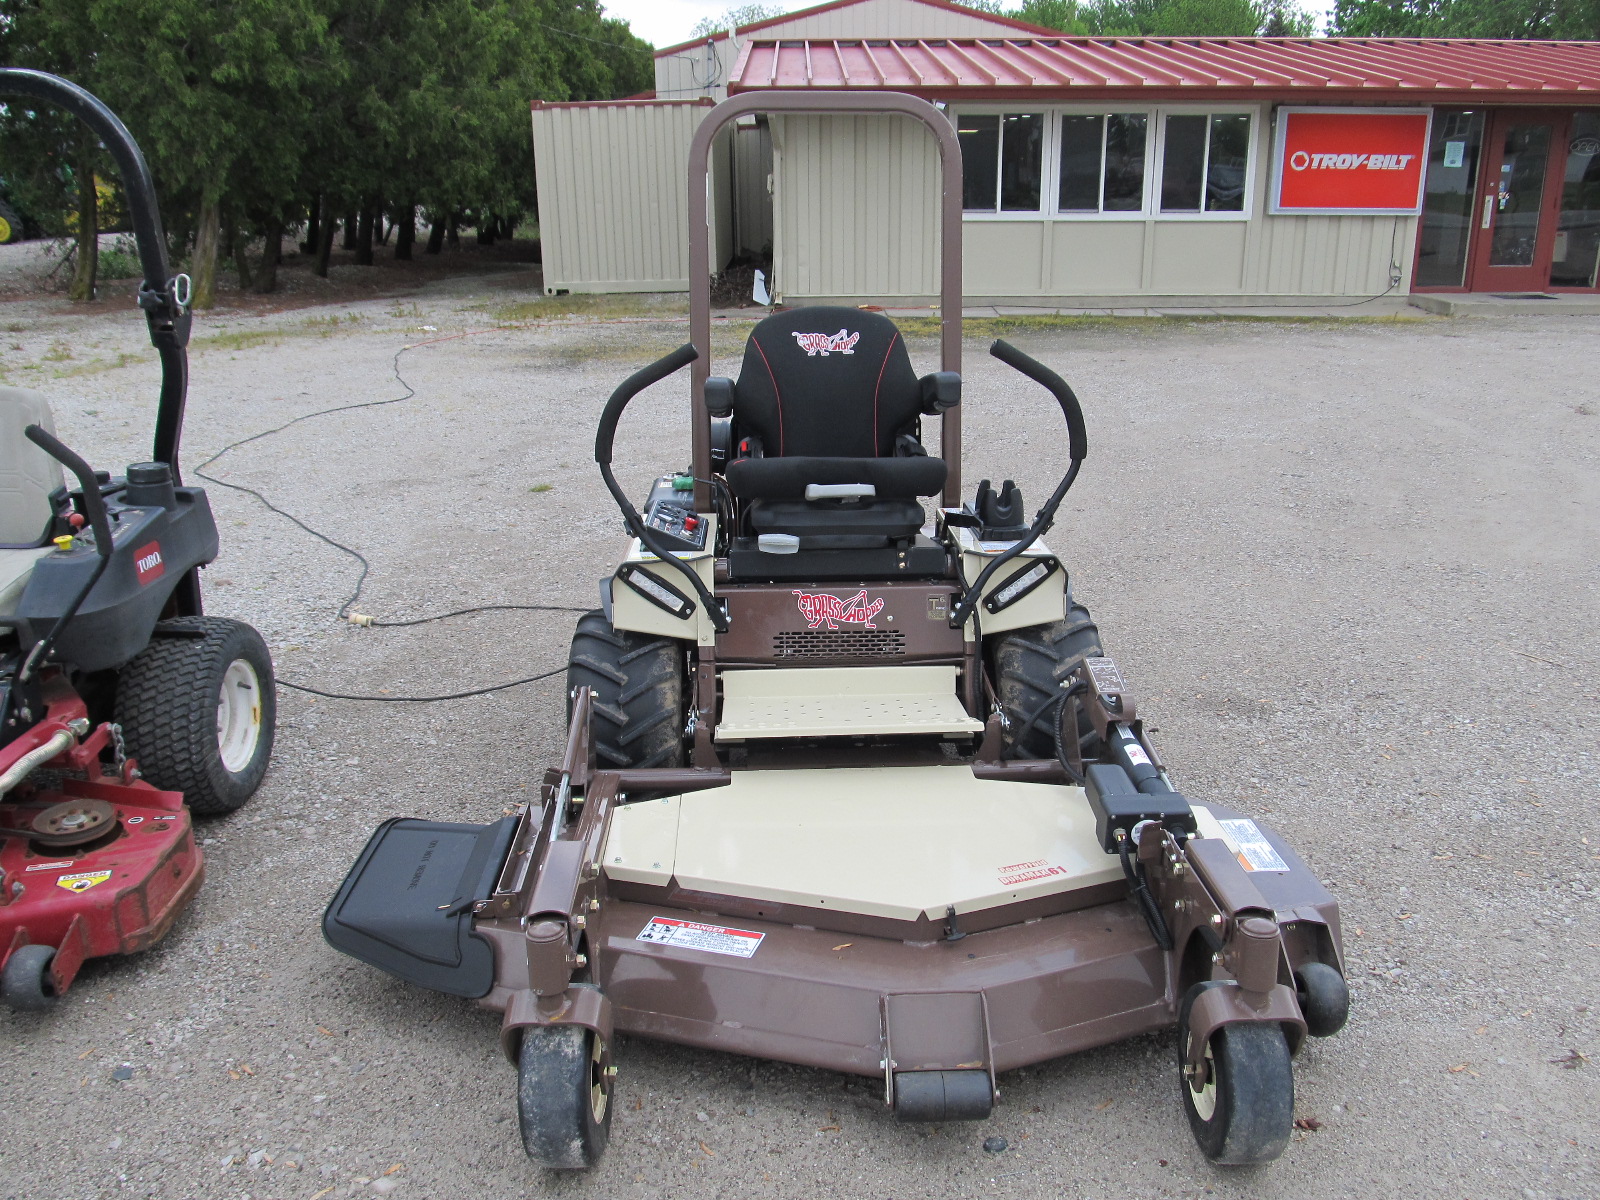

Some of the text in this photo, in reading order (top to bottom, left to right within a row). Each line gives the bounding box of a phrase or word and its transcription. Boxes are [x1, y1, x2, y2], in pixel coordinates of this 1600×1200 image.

[1310, 153, 1411, 170] TROY-BILT
[136, 551, 160, 573] TORO
[62, 871, 108, 880] DANGER
[1046, 865, 1067, 876] 61
[687, 922, 726, 933] DANGER
